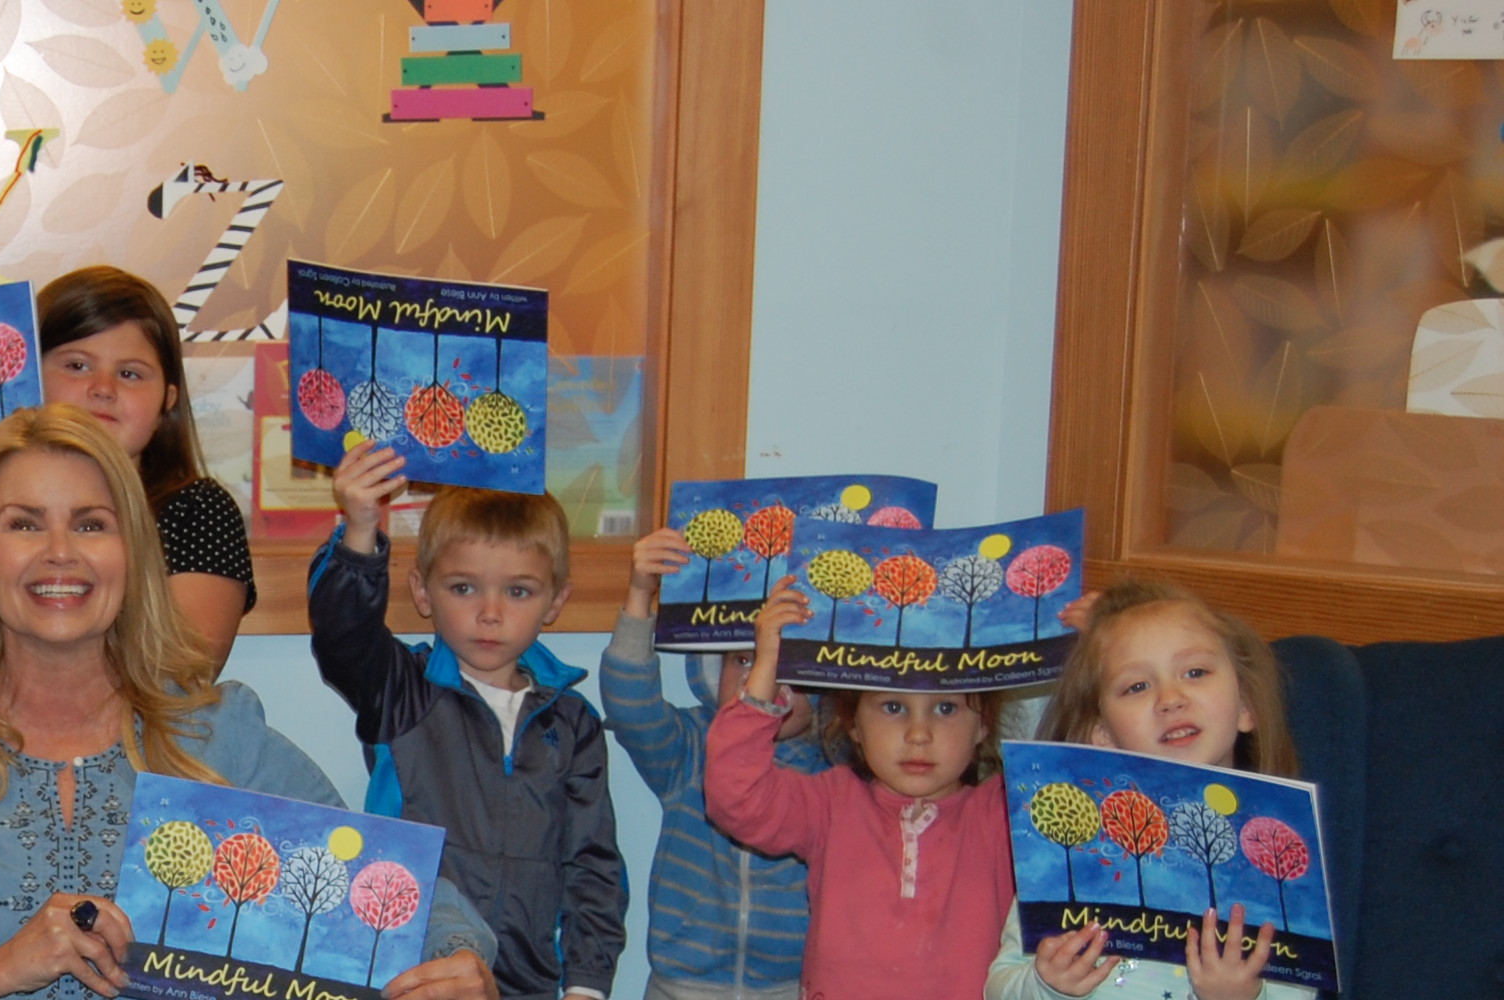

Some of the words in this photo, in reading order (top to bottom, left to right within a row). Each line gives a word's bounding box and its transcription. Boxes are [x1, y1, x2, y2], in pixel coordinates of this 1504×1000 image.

[468, 291, 487, 300] Ann
[315, 289, 381, 321] Moon
[389, 298, 511, 334] Mindful
[816, 645, 949, 675] Mindful
[957, 648, 1043, 672] Moon
[840, 669, 862, 680] Ann
[863, 671, 891, 683] Biese
[994, 667, 1036, 682] Colleen
[1116, 939, 1144, 952] Biese
[144, 950, 277, 996] Mindful
[152, 984, 163, 996] by
[165, 986, 188, 1000] Ann
